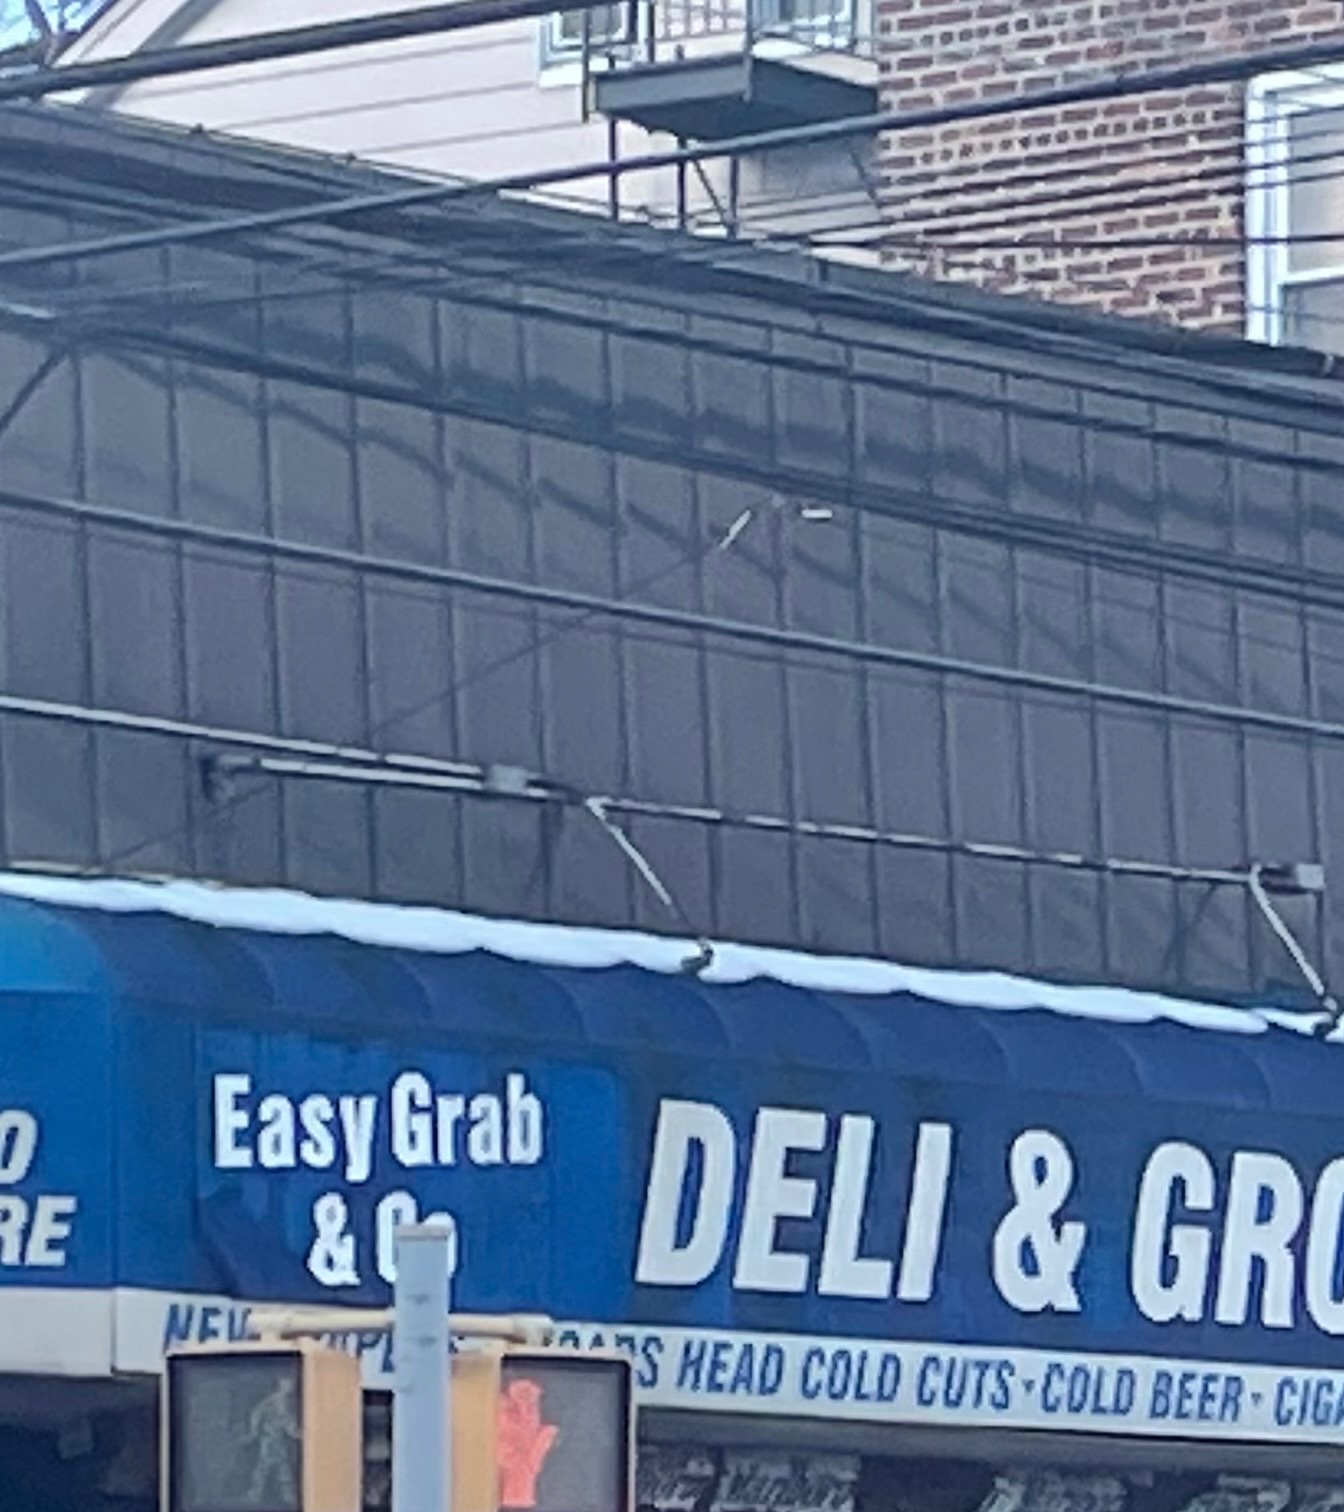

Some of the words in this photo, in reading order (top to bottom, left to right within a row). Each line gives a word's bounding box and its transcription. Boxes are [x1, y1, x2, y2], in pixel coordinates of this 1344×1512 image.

[213, 1073, 378, 1183] Easy
[391, 1070, 544, 1167] Grab
[307, 1192, 360, 1286] &
[635, 1099, 952, 1301] DELI
[992, 1129, 1087, 1313] &
[676, 1339, 784, 1397] HEAD
[801, 1345, 900, 1402] COLD
[915, 1355, 1016, 1411] CUTS
[1040, 1362, 1136, 1417] COLD
[1148, 1369, 1244, 1424] BEER
